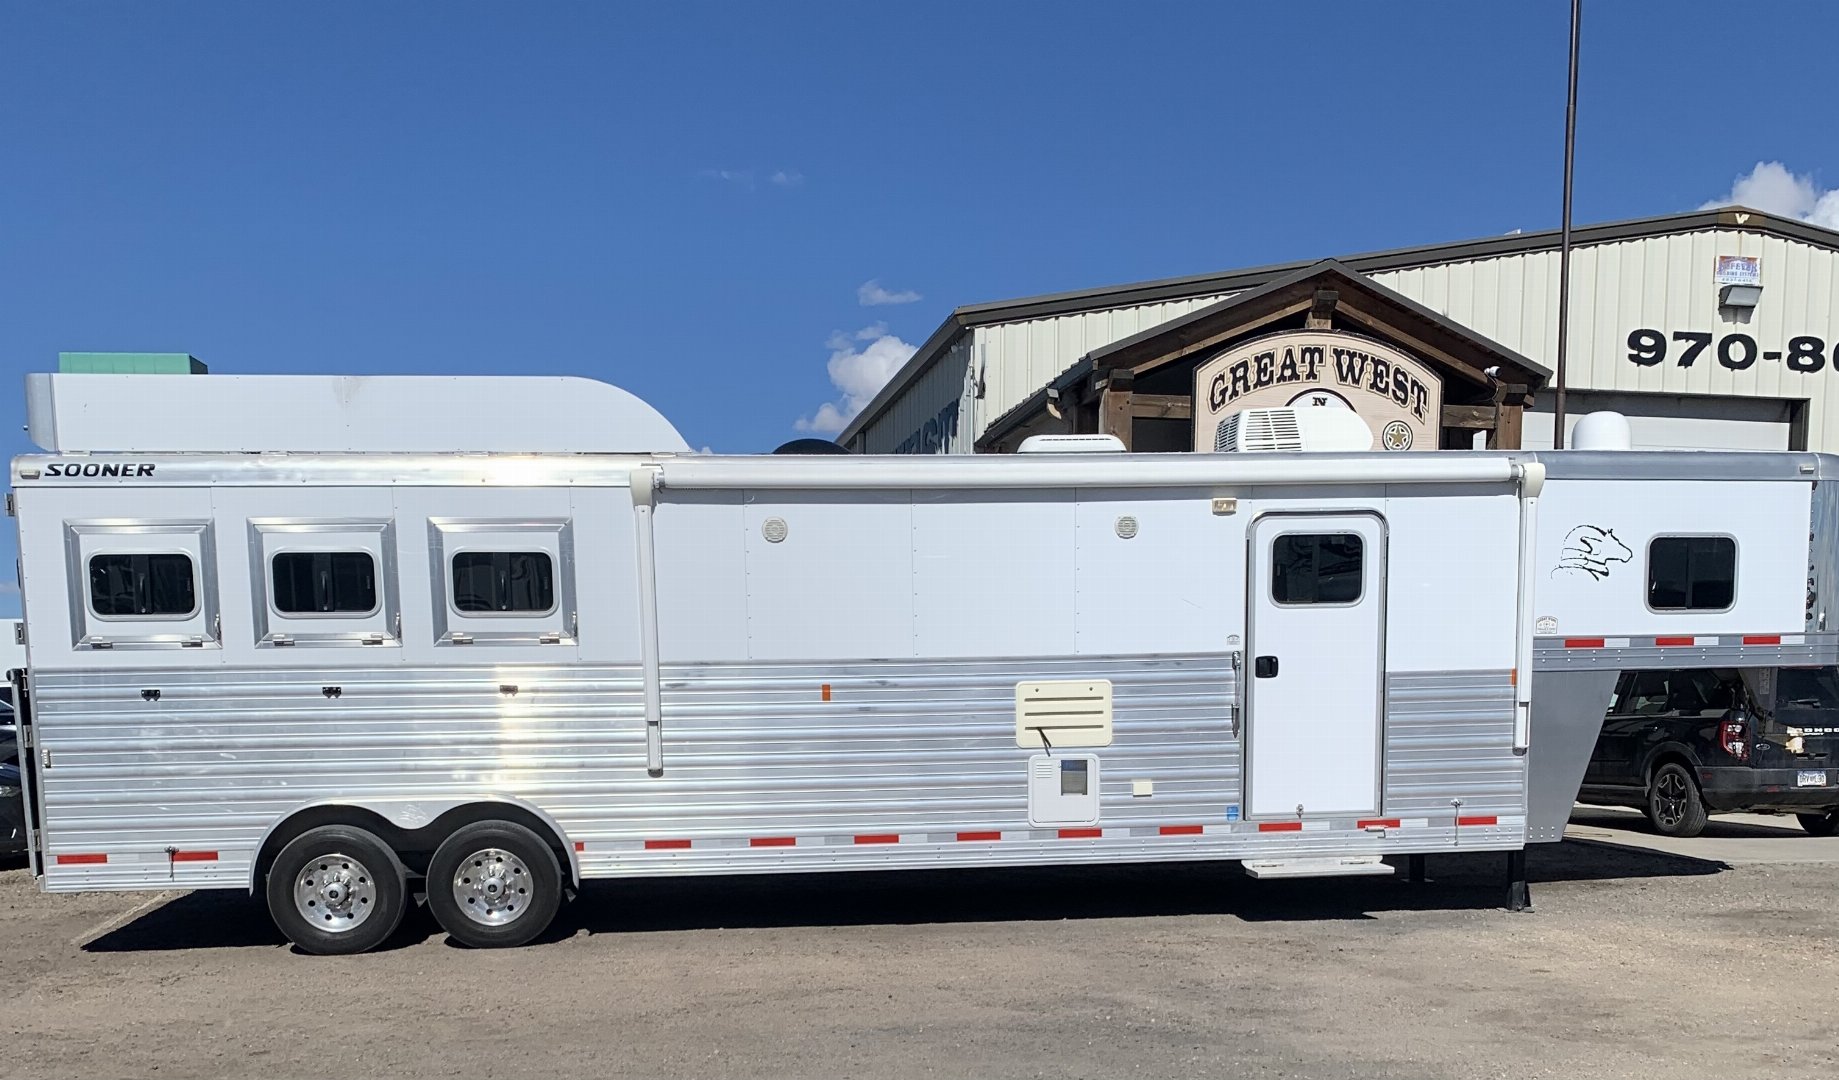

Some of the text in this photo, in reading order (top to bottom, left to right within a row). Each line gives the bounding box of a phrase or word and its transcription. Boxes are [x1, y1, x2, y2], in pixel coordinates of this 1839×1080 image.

[1627, 328, 1839, 374] 970-8
[1209, 346, 1429, 420] GREAT WEST
[1312, 396, 1328, 407] N
[44, 463, 156, 477] SOONER
